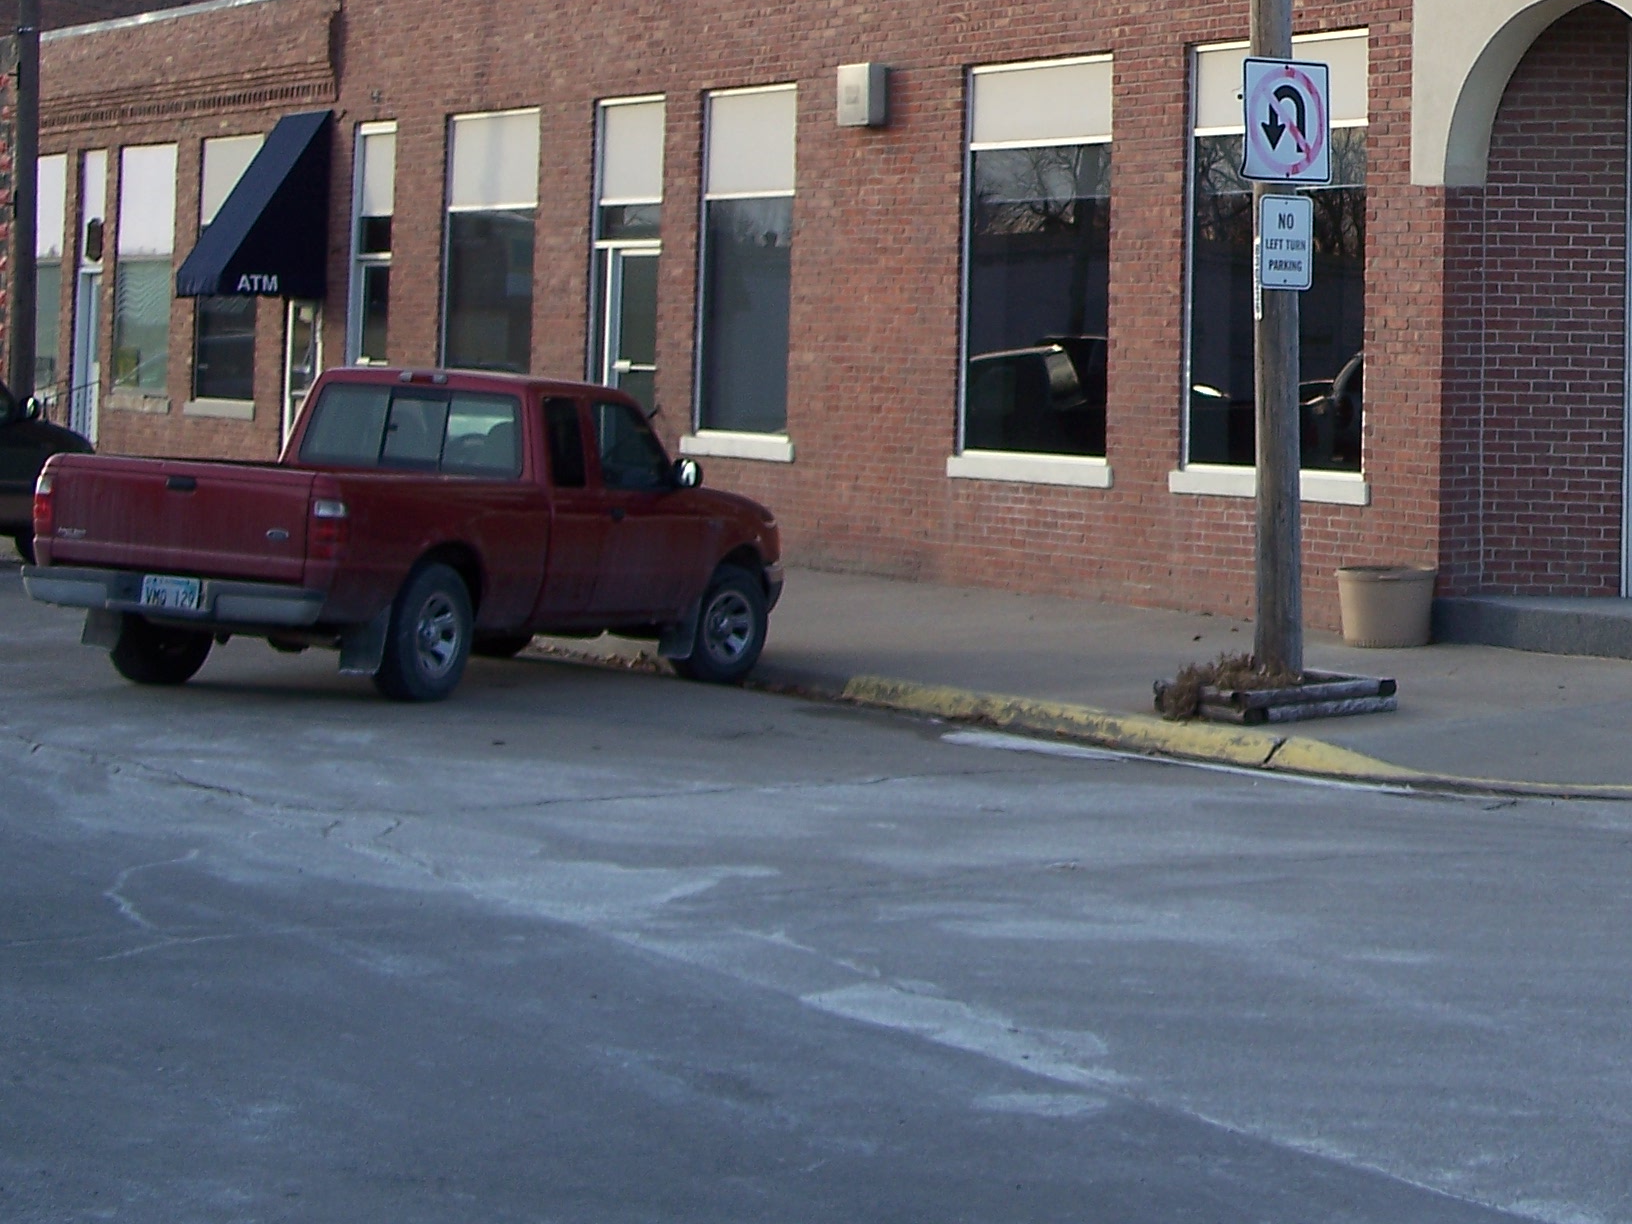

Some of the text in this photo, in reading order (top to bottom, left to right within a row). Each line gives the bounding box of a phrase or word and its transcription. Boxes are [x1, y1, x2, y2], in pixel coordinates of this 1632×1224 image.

[1278, 213, 1294, 230] NO
[1265, 239, 1306, 251] LEFT TURN
[1268, 259, 1302, 272] PARKING
[236, 273, 279, 293] ATM
